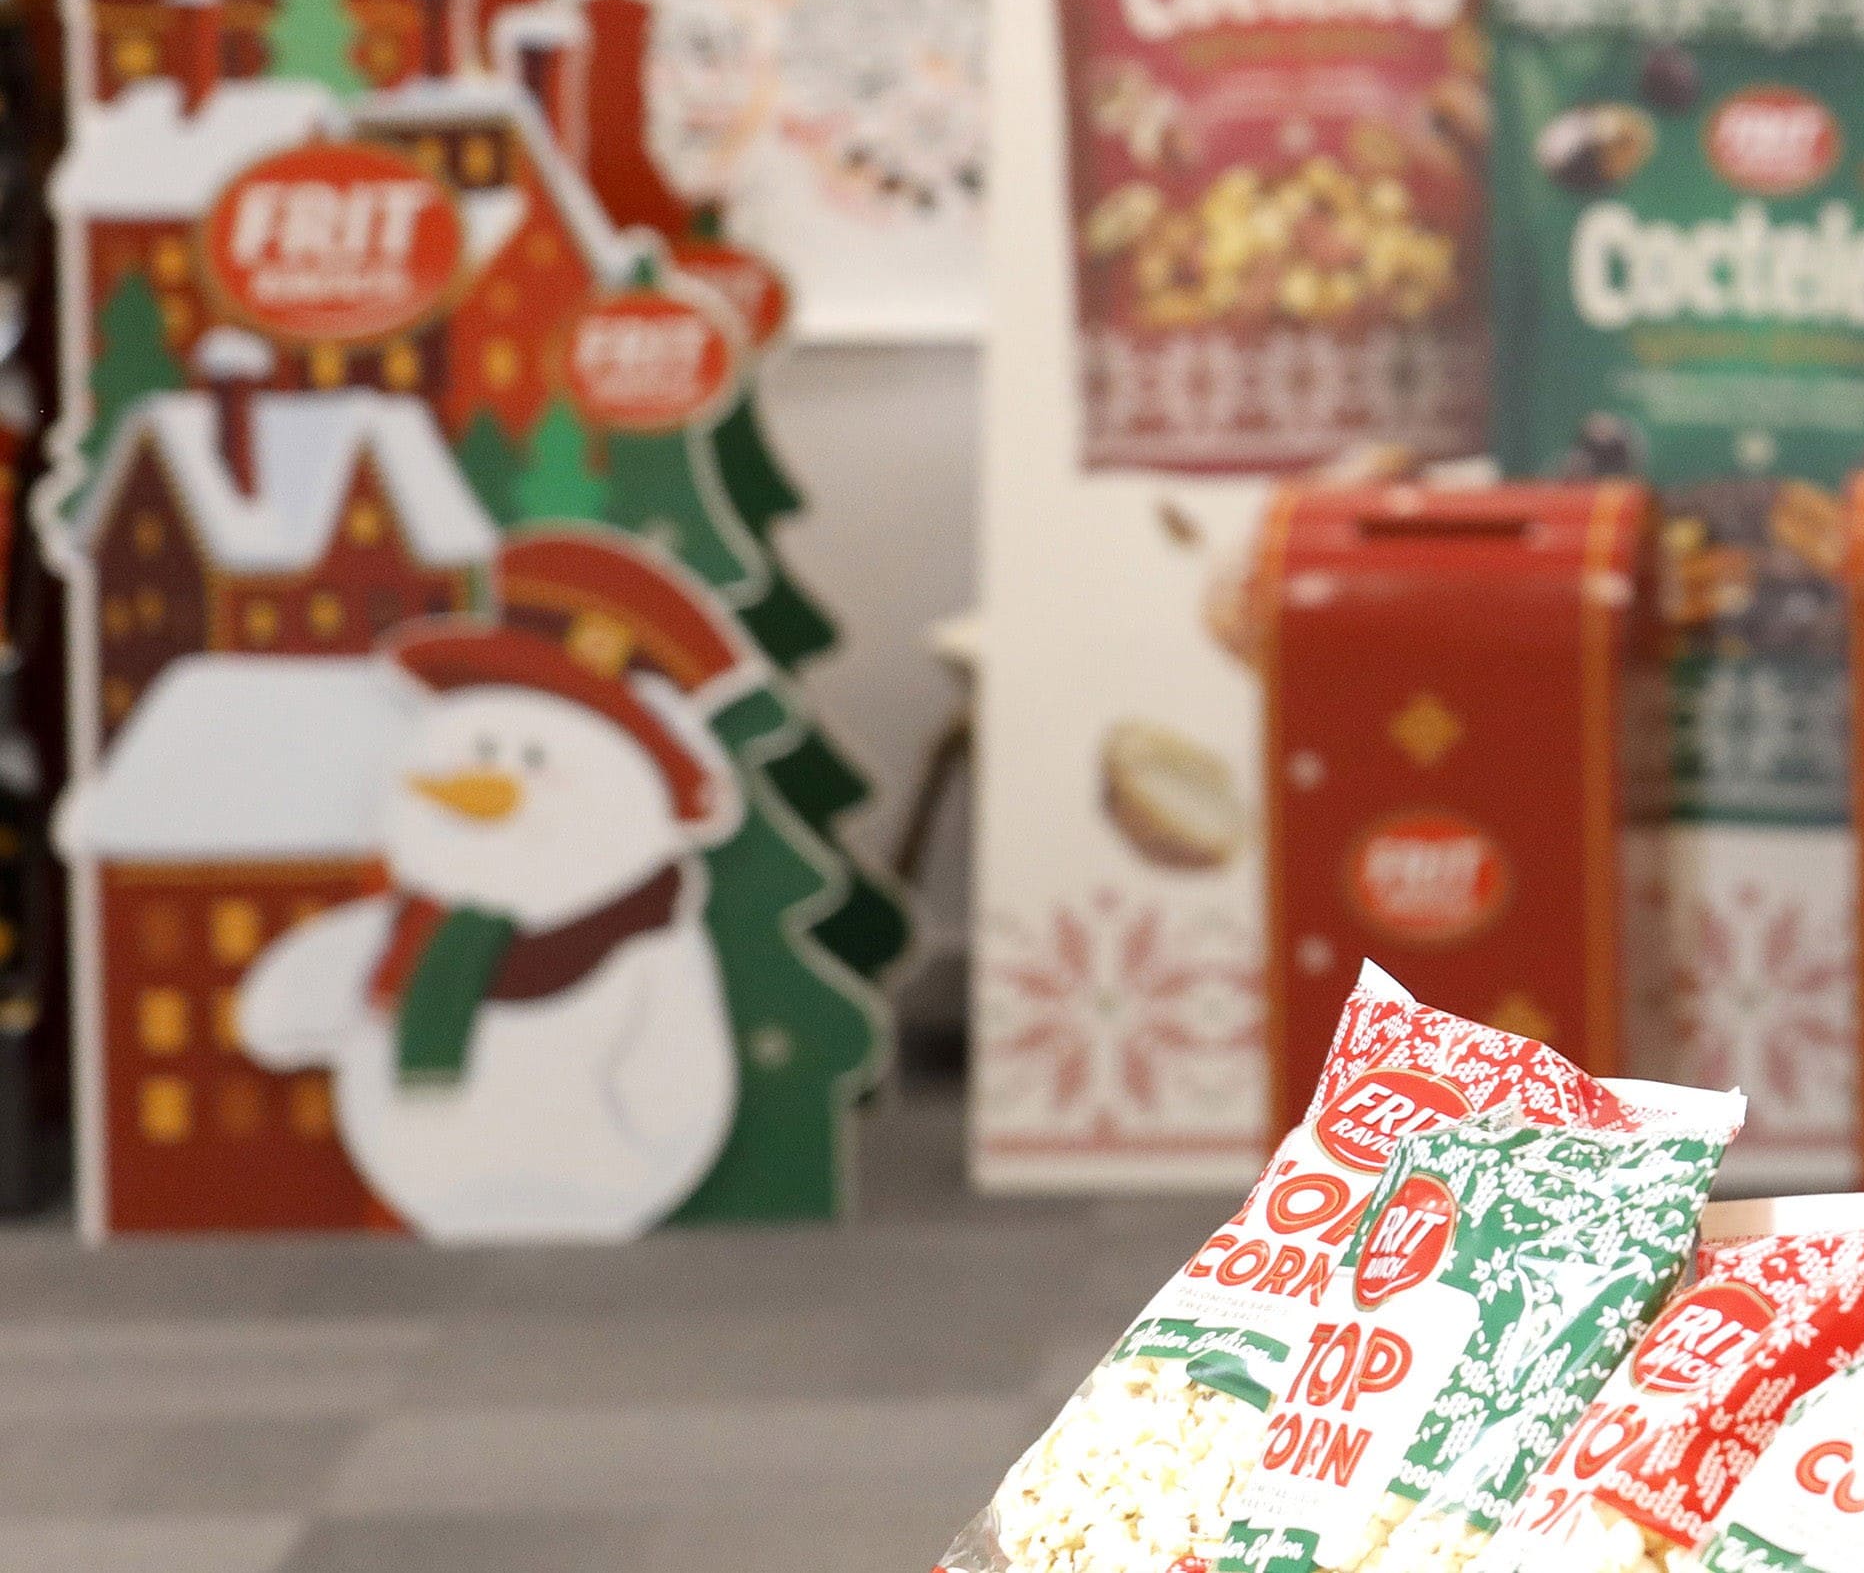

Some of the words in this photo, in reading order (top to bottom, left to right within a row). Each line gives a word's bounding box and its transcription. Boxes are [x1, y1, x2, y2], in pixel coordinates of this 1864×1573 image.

[232, 180, 434, 265] FRIT
[1329, 1117, 1400, 1159] RAVIC
[1285, 1321, 1414, 1412] TOP
